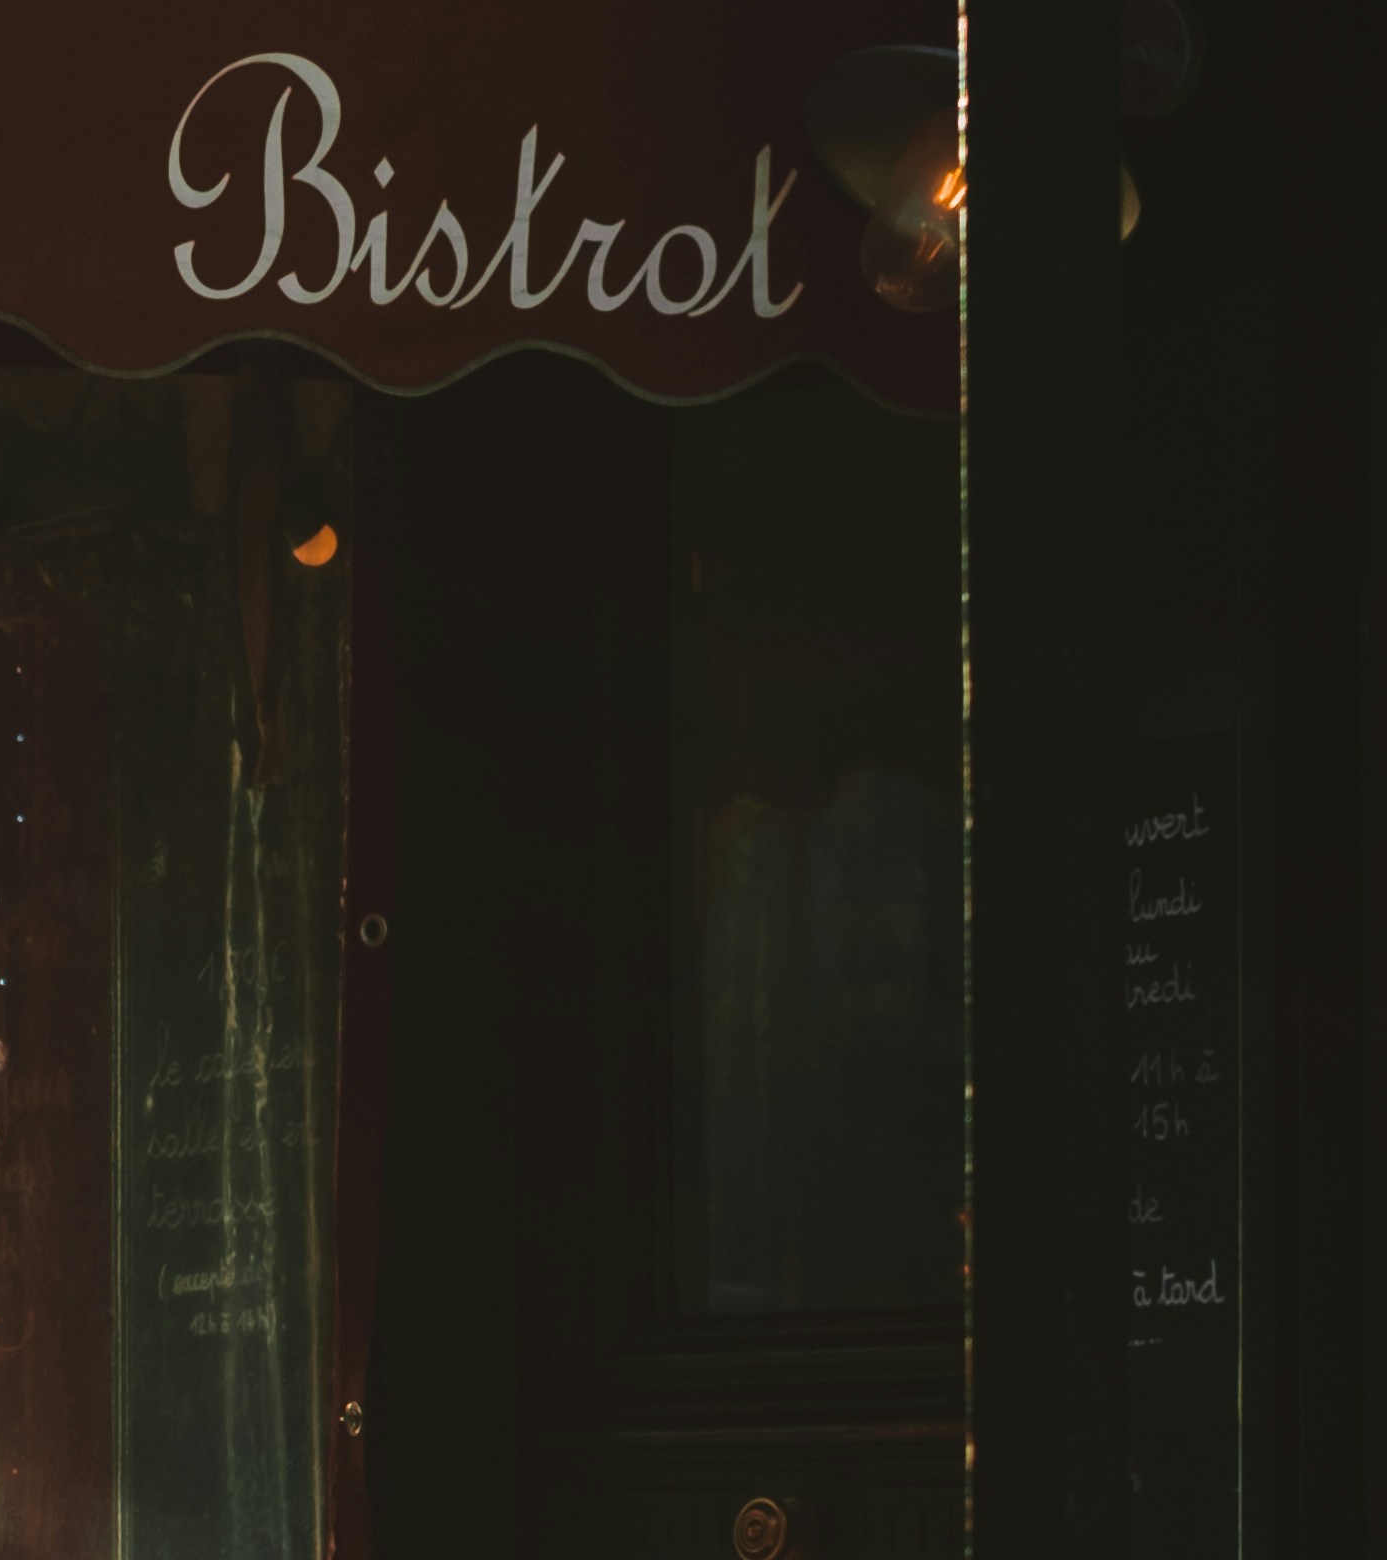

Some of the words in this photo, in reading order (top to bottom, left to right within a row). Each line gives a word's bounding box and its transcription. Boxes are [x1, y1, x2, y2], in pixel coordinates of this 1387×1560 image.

[167, 51, 804, 320] Bistrot
[1127, 867, 1204, 924] lundi
[1157, 1256, 1227, 1307] tard
